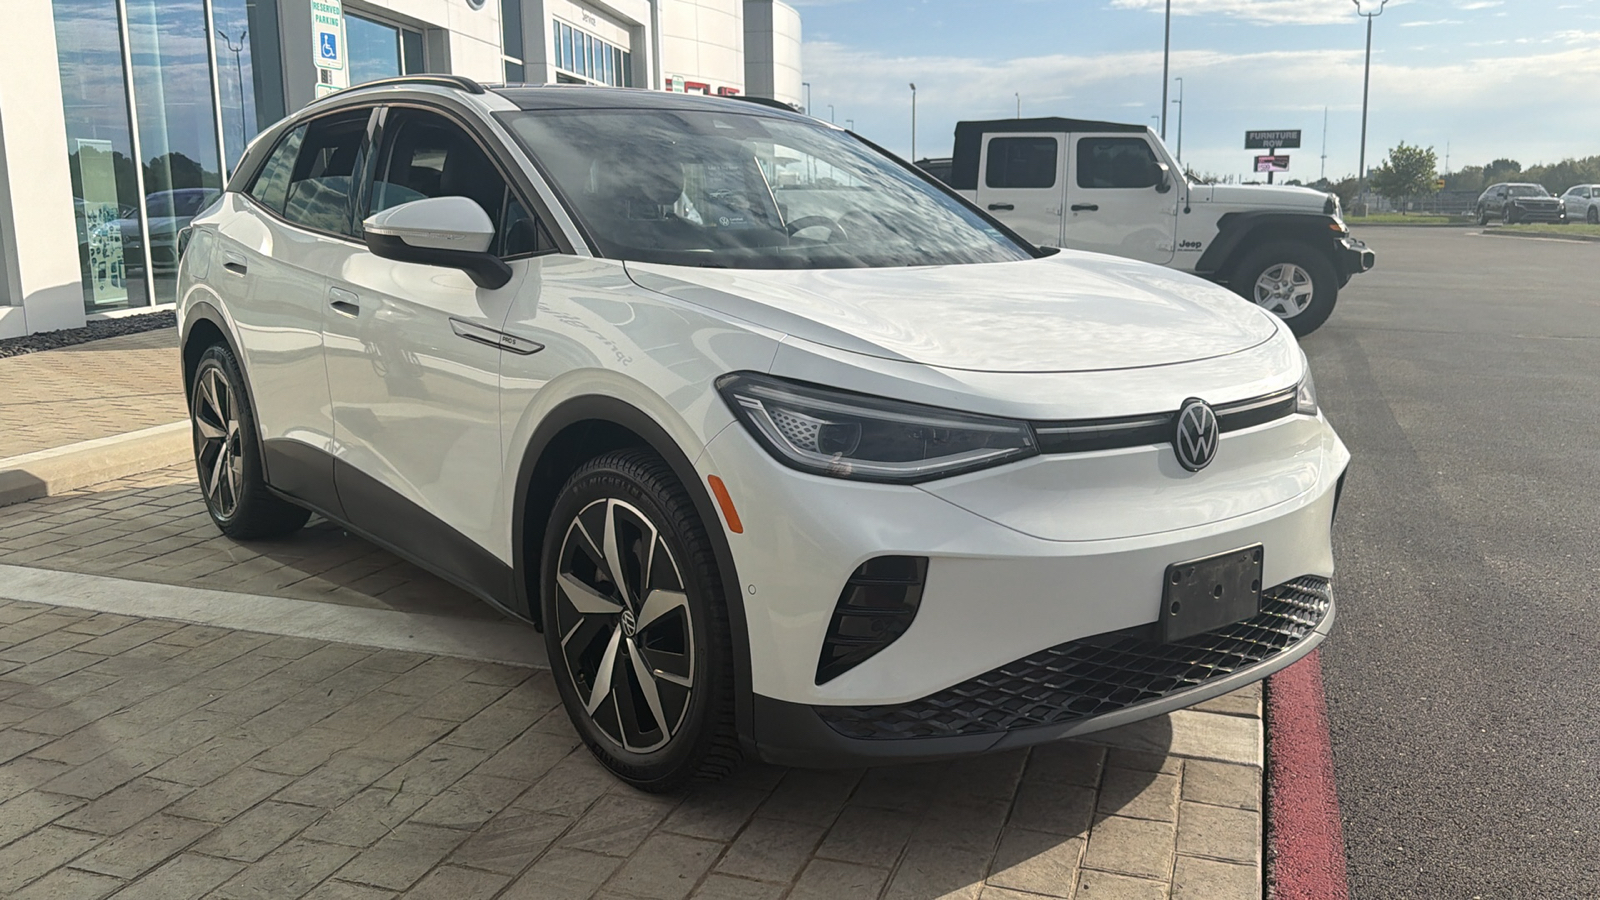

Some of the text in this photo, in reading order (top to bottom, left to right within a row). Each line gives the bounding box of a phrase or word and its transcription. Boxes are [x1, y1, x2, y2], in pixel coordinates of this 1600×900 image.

[313, 2, 340, 15] RESERVED
[315, 14, 338, 26] PARKING
[1249, 131, 1298, 140] FURNITURE
[1178, 239, 1202, 249] Jeep
[589, 476, 639, 495] MICHELIN
